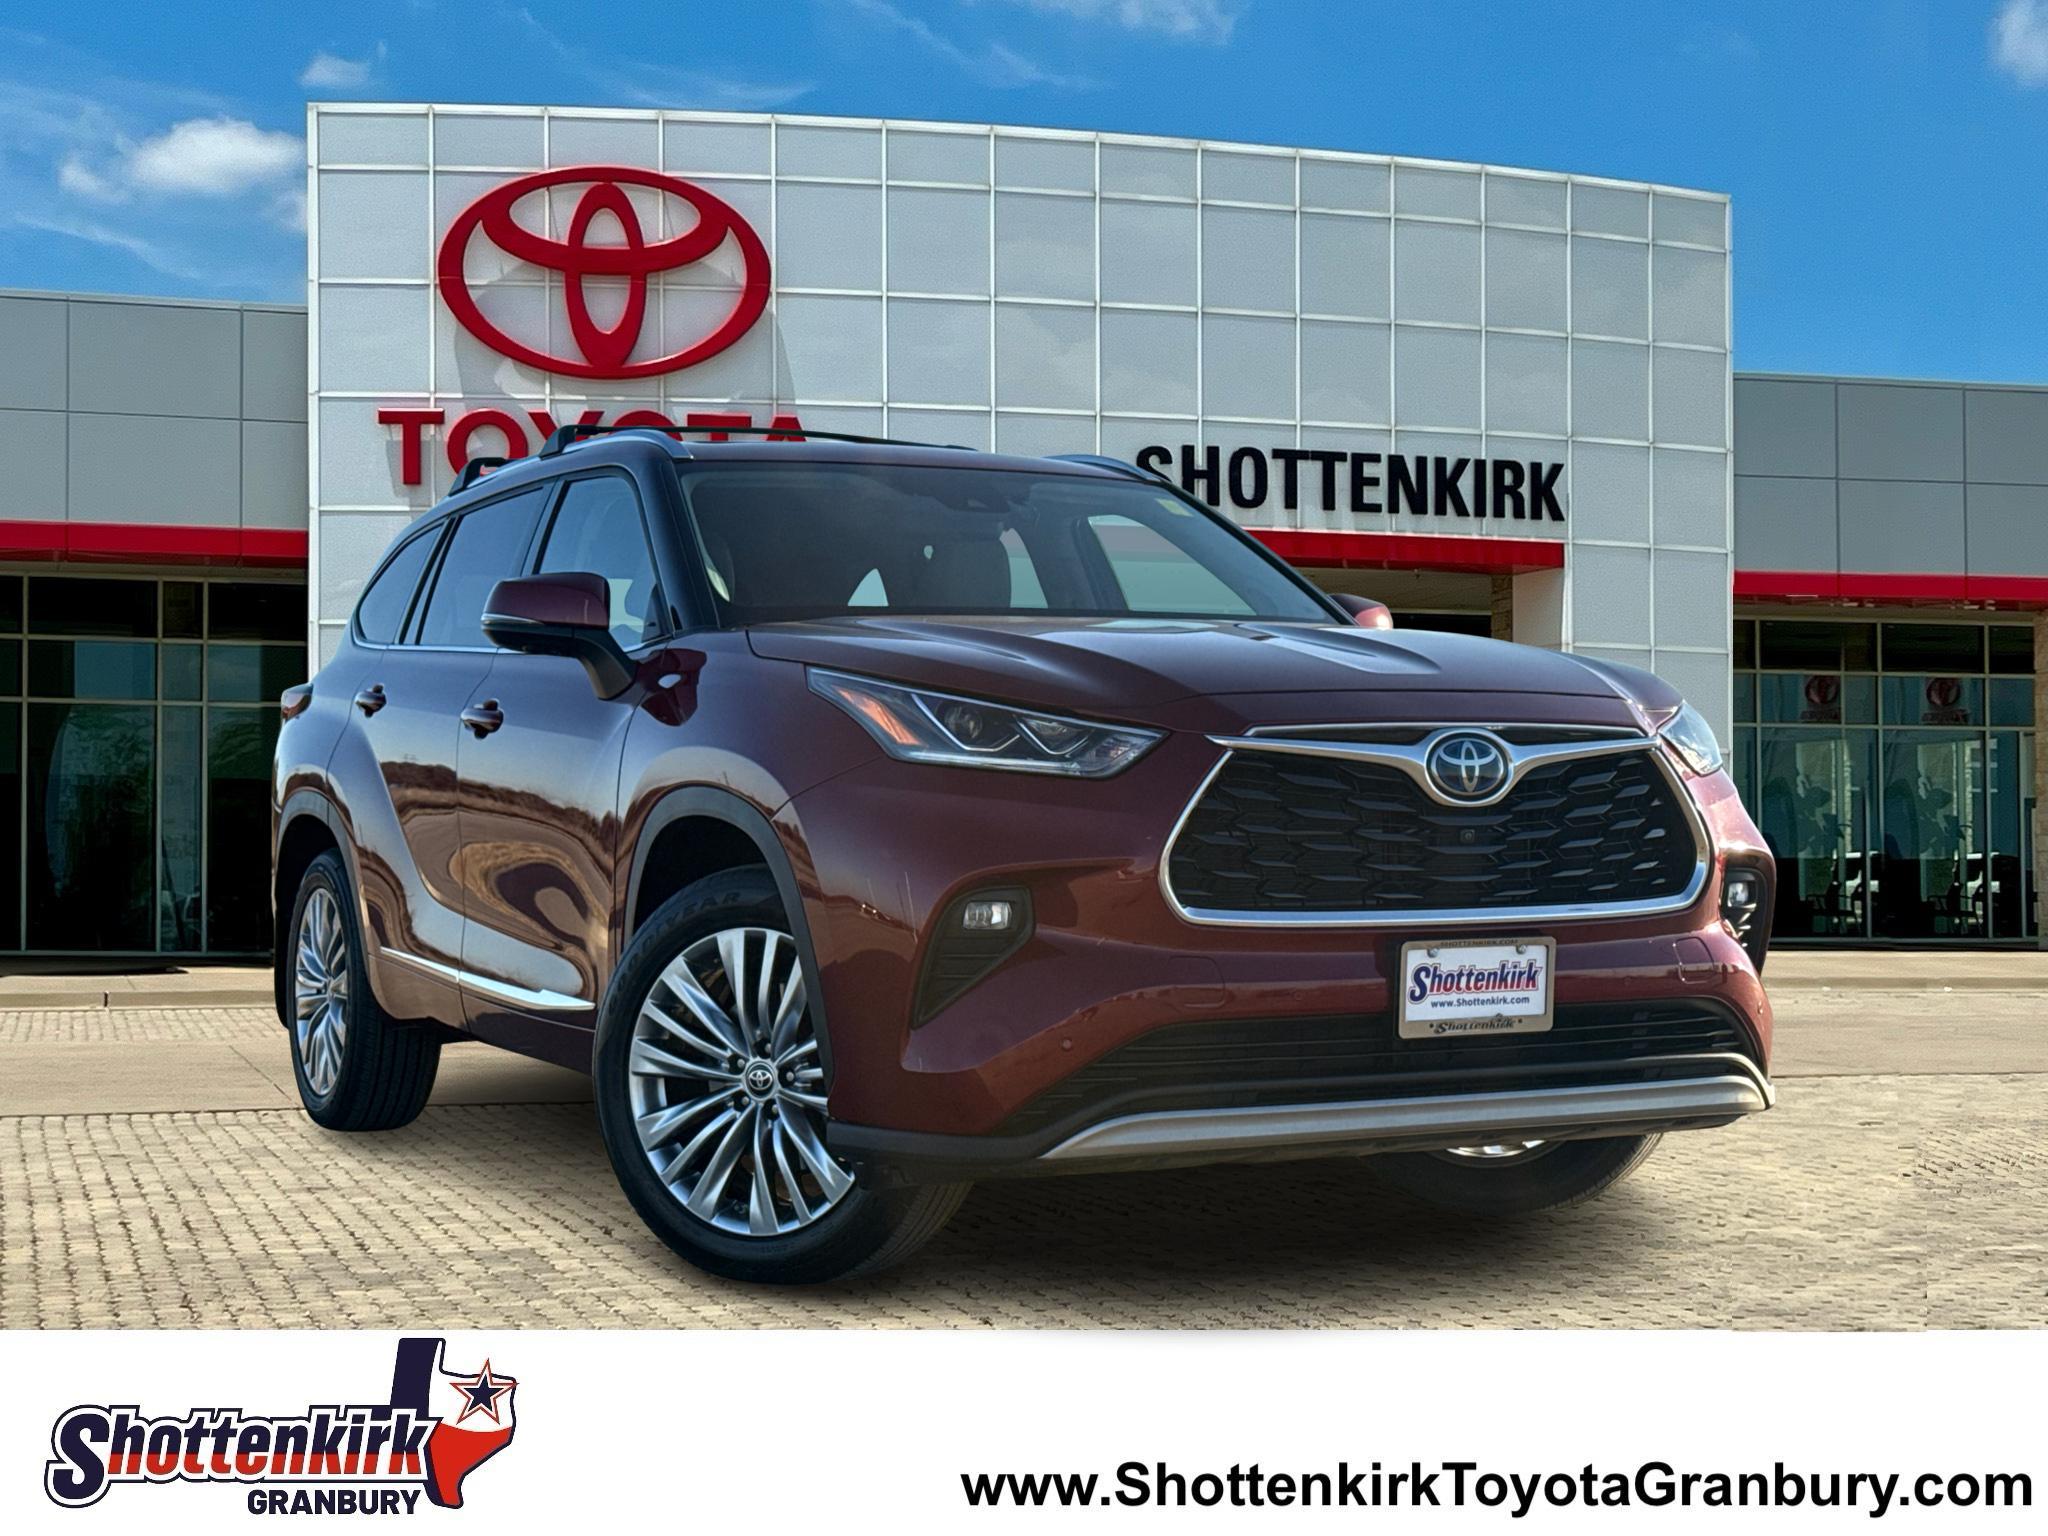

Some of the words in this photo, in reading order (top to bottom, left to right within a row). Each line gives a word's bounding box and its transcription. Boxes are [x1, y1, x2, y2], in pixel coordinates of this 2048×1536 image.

[1136, 445, 1565, 521] SHOTTENKIRK
[1409, 960, 1541, 1003] Shottenkirk
[1431, 995, 1531, 1008] www.Shottenkirk.com
